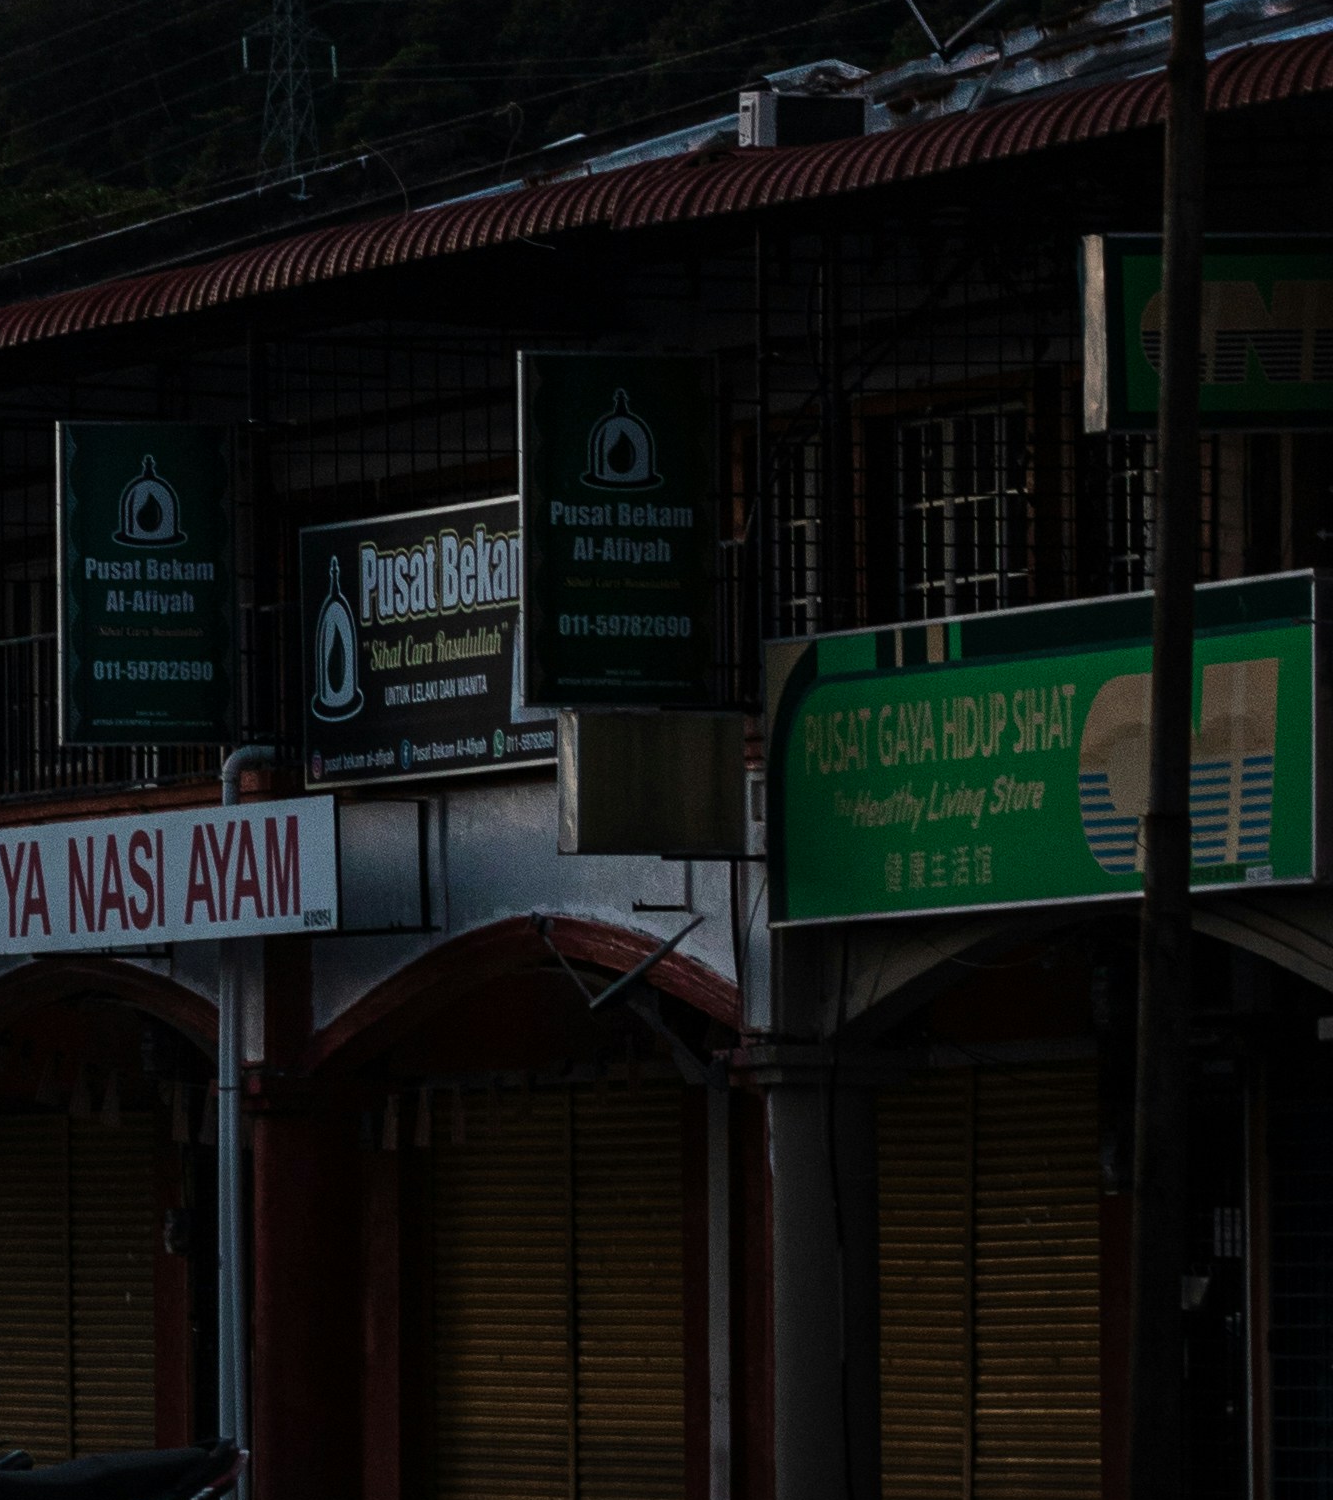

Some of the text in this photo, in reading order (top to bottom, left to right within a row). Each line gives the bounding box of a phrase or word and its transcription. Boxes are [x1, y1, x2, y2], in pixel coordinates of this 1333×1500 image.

[550, 500, 694, 527] Pusat Bekam
[573, 536, 671, 564] Al-Afiyah
[85, 557, 215, 581] Pusat Bekam
[360, 540, 437, 622] Pusat
[105, 589, 195, 616] Al-Afiyah
[558, 613, 694, 638] 011-59782690
[93, 660, 215, 682] 011-59782690
[804, 683, 1076, 775] PUSAT GAYA HIDUP SIHAT
[852, 779, 926, 834] Healthy
[926, 779, 986, 829] Living
[989, 773, 1045, 815] Store
[69, 829, 166, 934] NASI
[184, 816, 301, 925] AYAM
